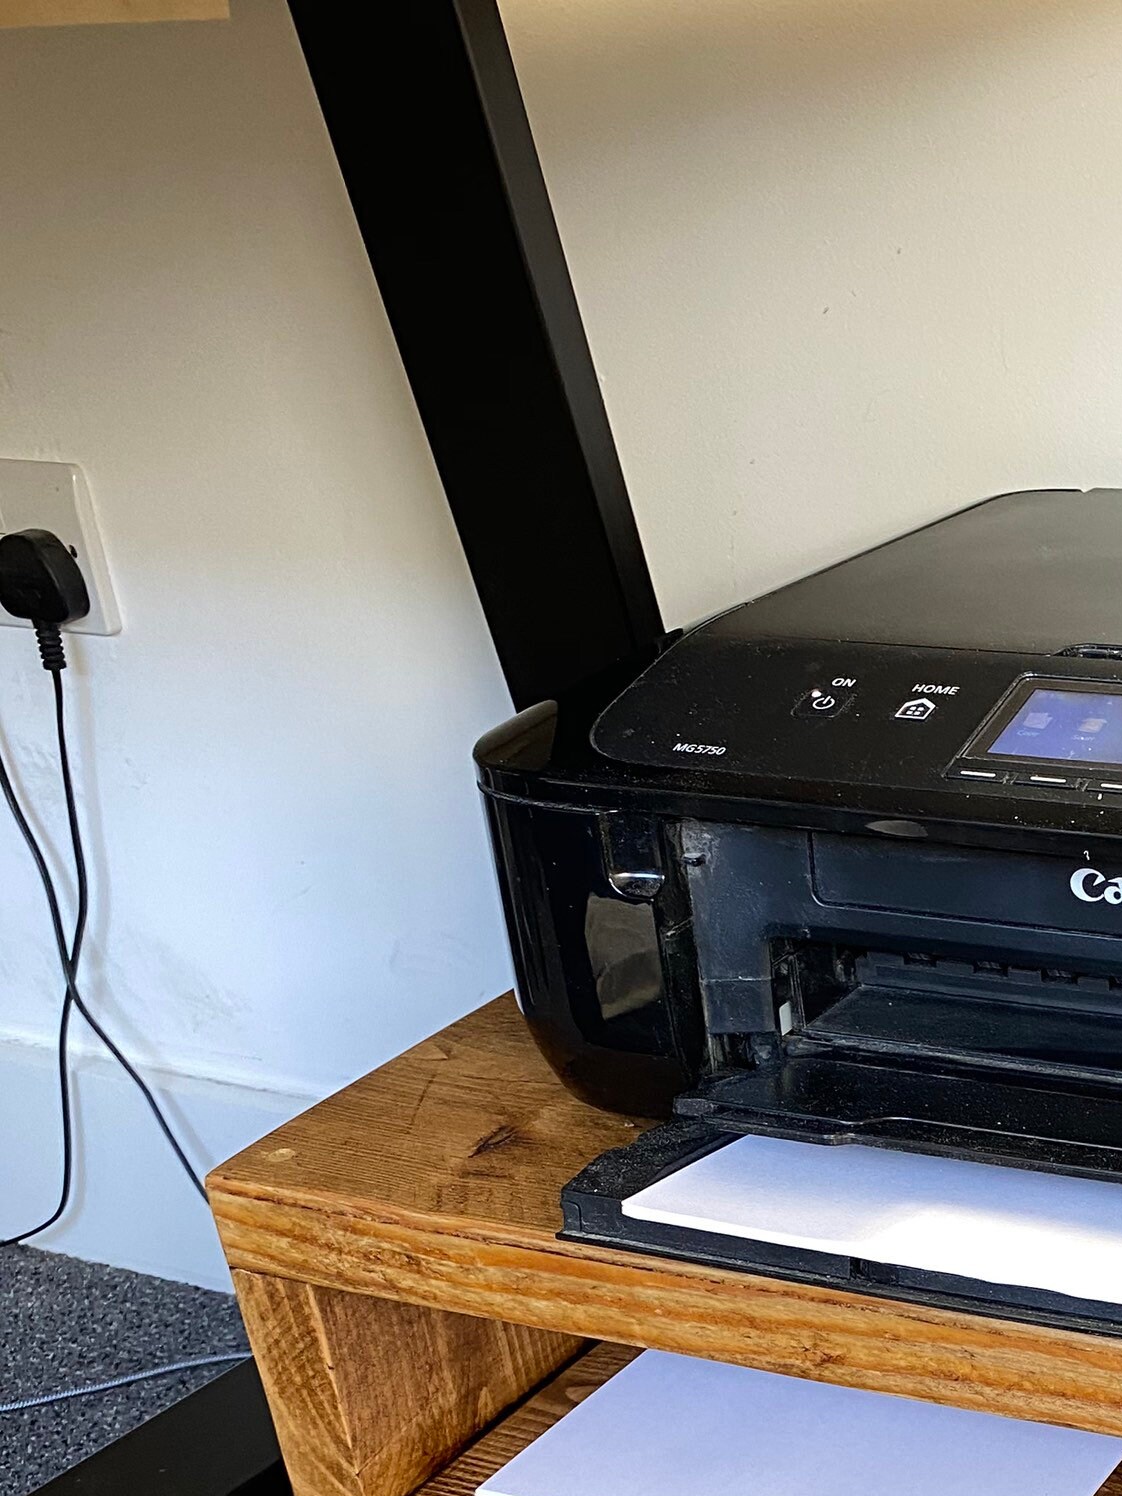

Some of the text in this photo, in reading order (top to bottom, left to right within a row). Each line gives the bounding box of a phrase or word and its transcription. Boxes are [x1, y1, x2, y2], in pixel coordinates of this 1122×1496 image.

[831, 677, 857, 688] ON
[911, 683, 960, 696] HOME
[672, 742, 727, 756] MG5750
